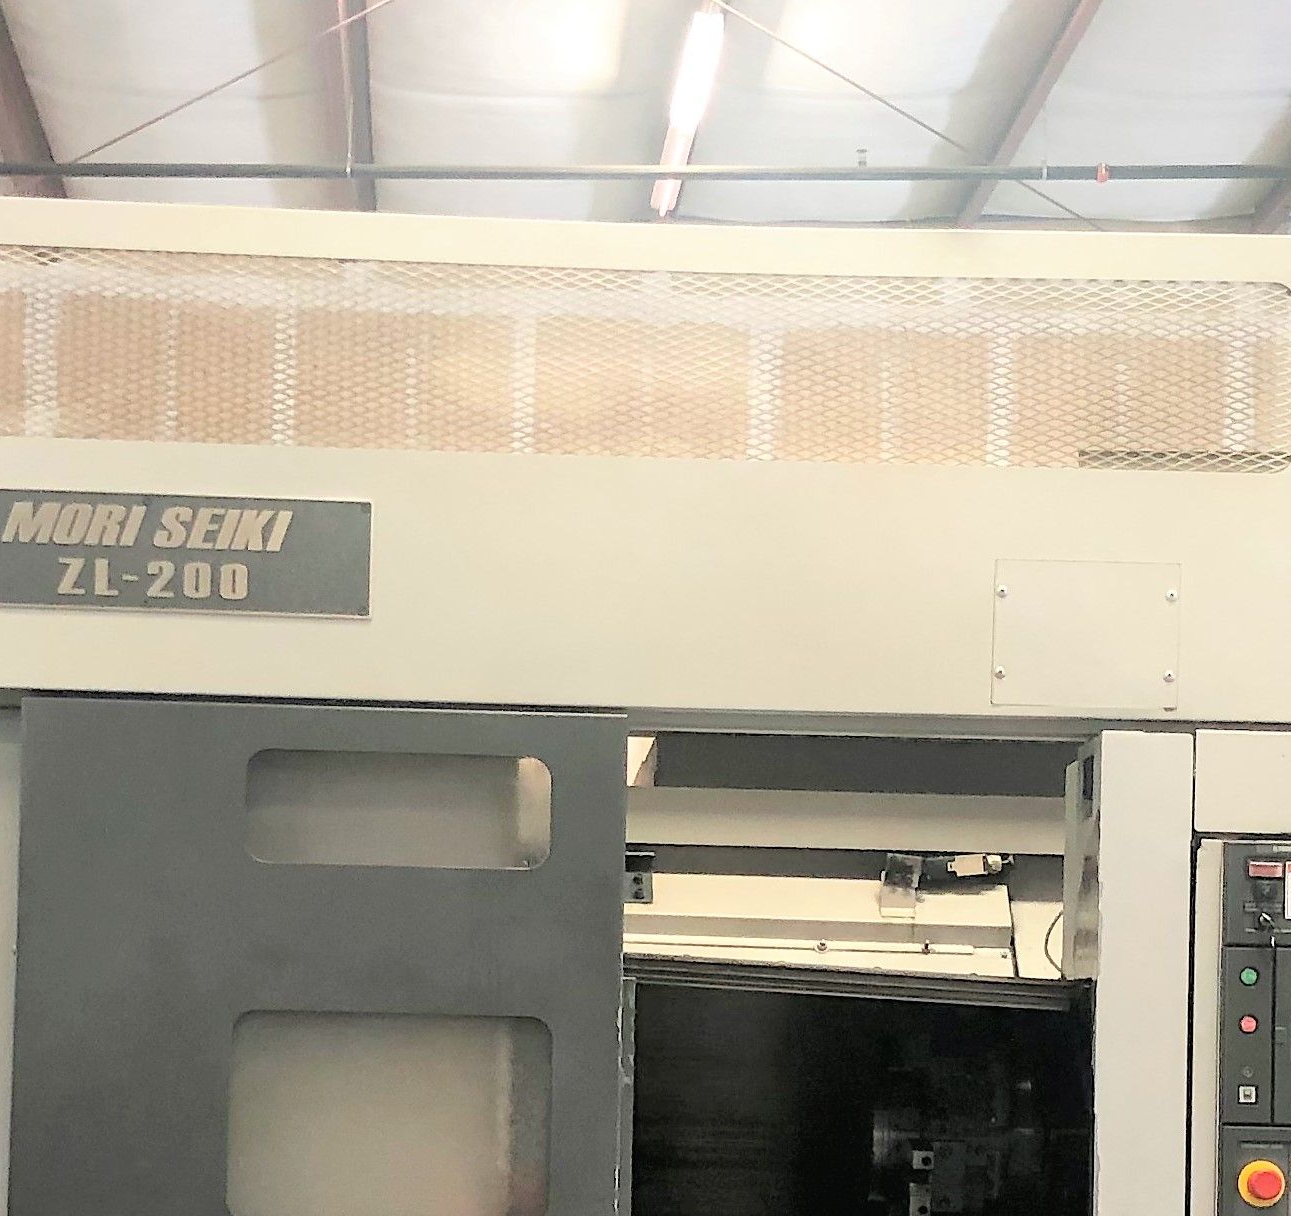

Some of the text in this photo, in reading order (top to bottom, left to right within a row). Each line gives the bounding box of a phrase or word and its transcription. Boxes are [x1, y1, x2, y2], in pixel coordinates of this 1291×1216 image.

[0, 501, 294, 551] MORI SEIKI
[56, 556, 249, 600] ZL-200
